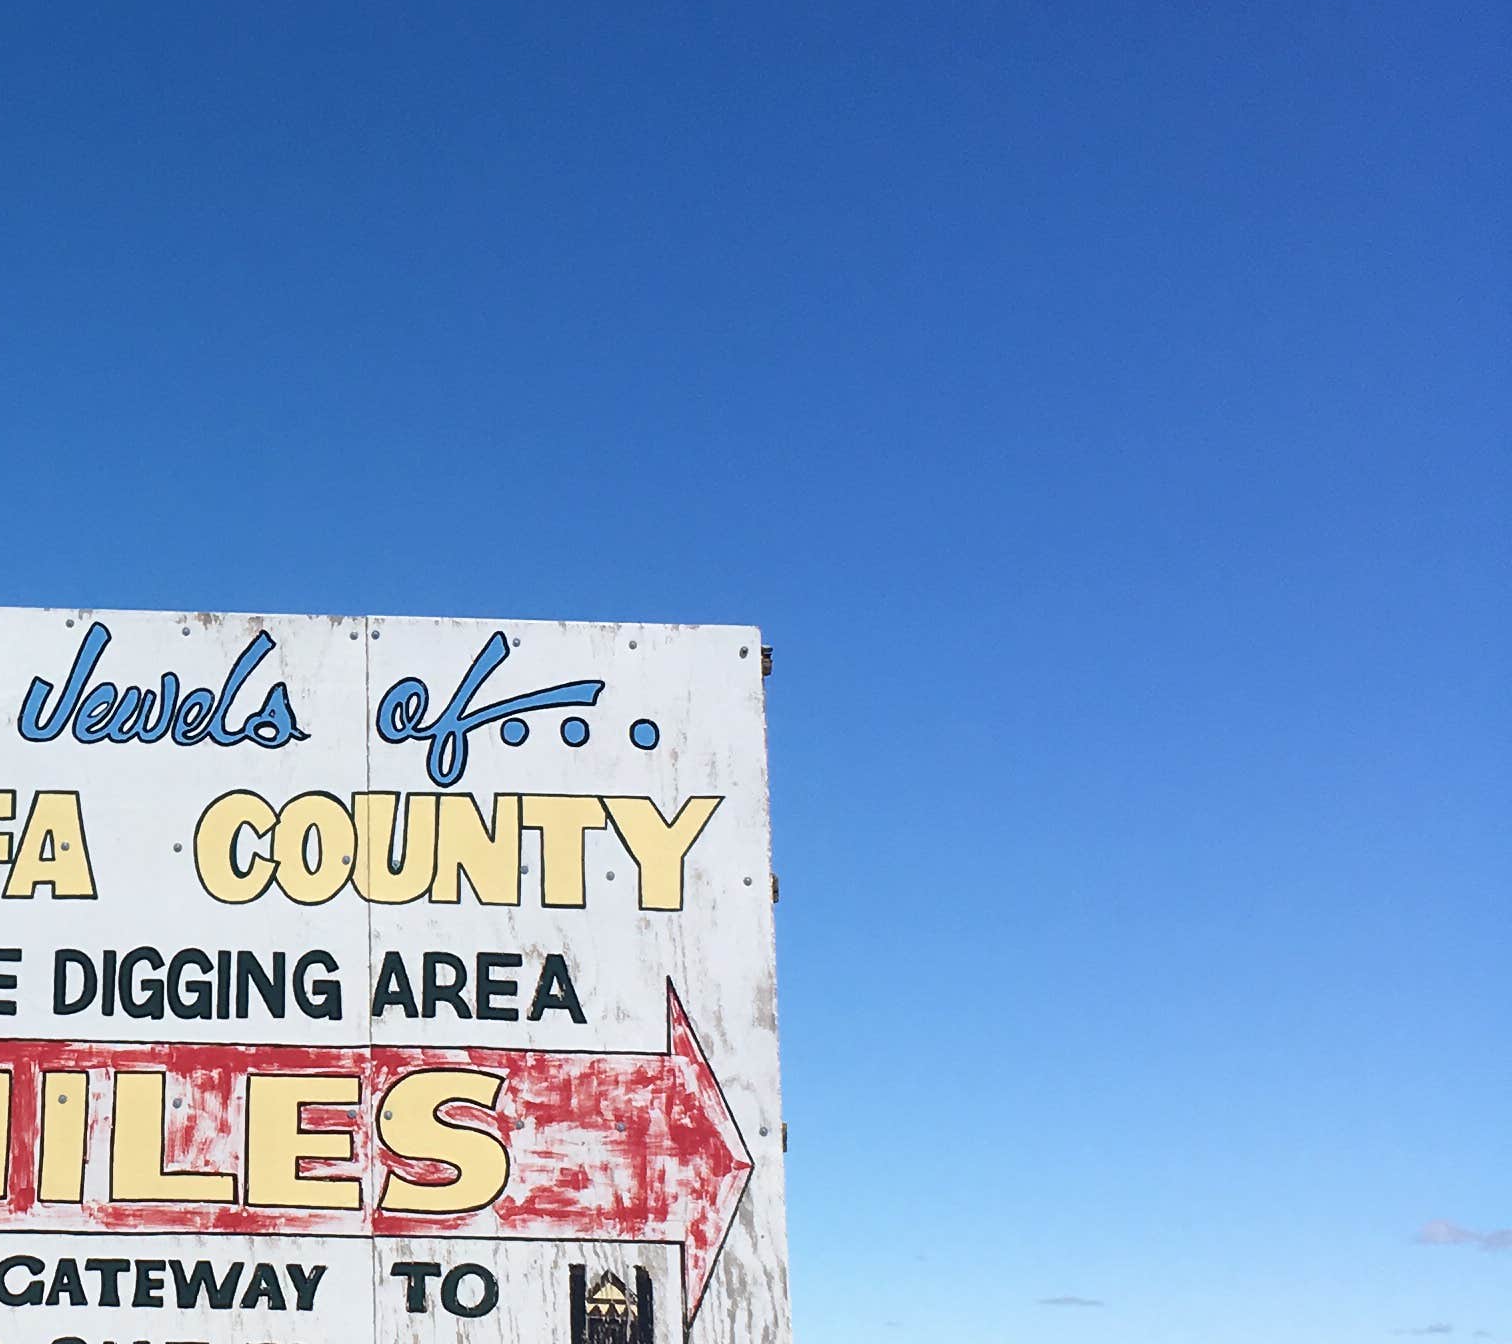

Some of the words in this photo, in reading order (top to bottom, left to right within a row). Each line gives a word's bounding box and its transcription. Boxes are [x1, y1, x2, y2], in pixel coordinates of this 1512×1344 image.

[18, 622, 310, 749] Jewels
[193, 789, 725, 911] COUNTY
[53, 946, 343, 1021] DIGGING
[371, 951, 588, 1024] AREA
[390, 1262, 500, 1318] TO
